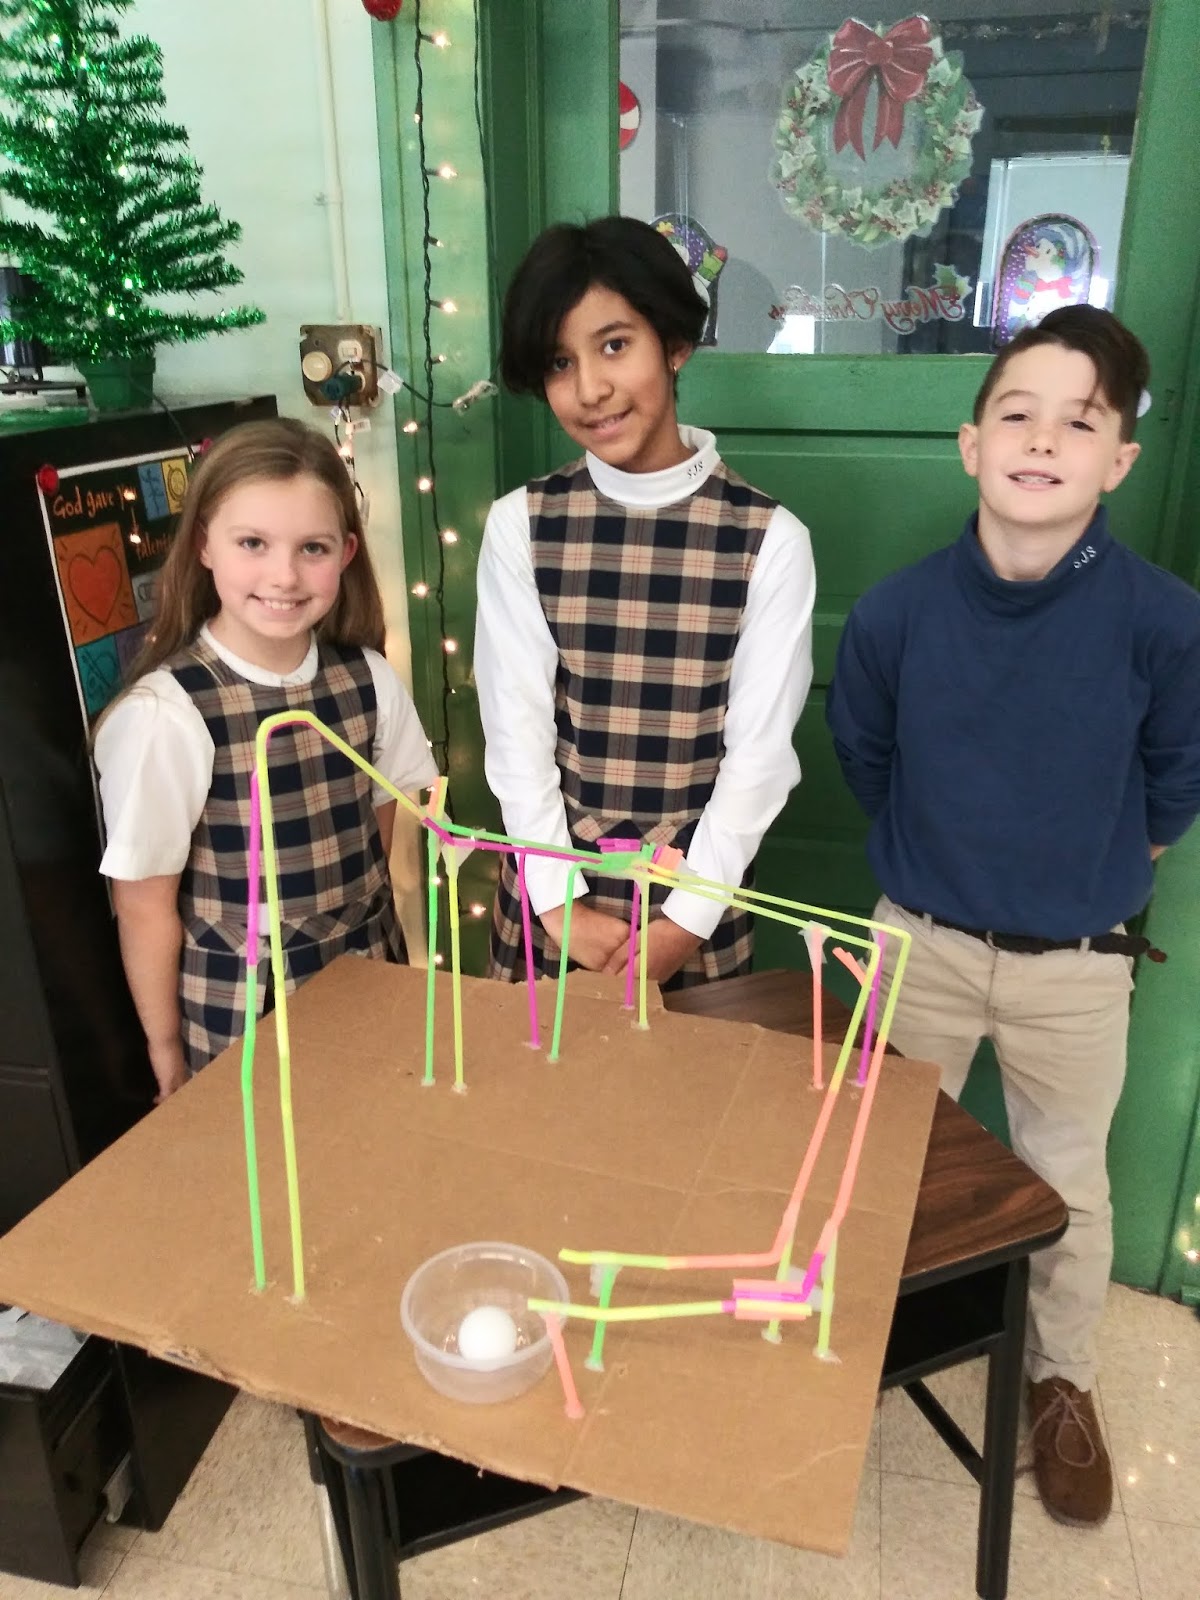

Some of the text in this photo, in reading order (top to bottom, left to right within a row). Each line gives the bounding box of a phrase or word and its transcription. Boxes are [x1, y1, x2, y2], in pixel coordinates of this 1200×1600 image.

[686, 460, 704, 480] SJS
[53, 484, 138, 519] God gave yu
